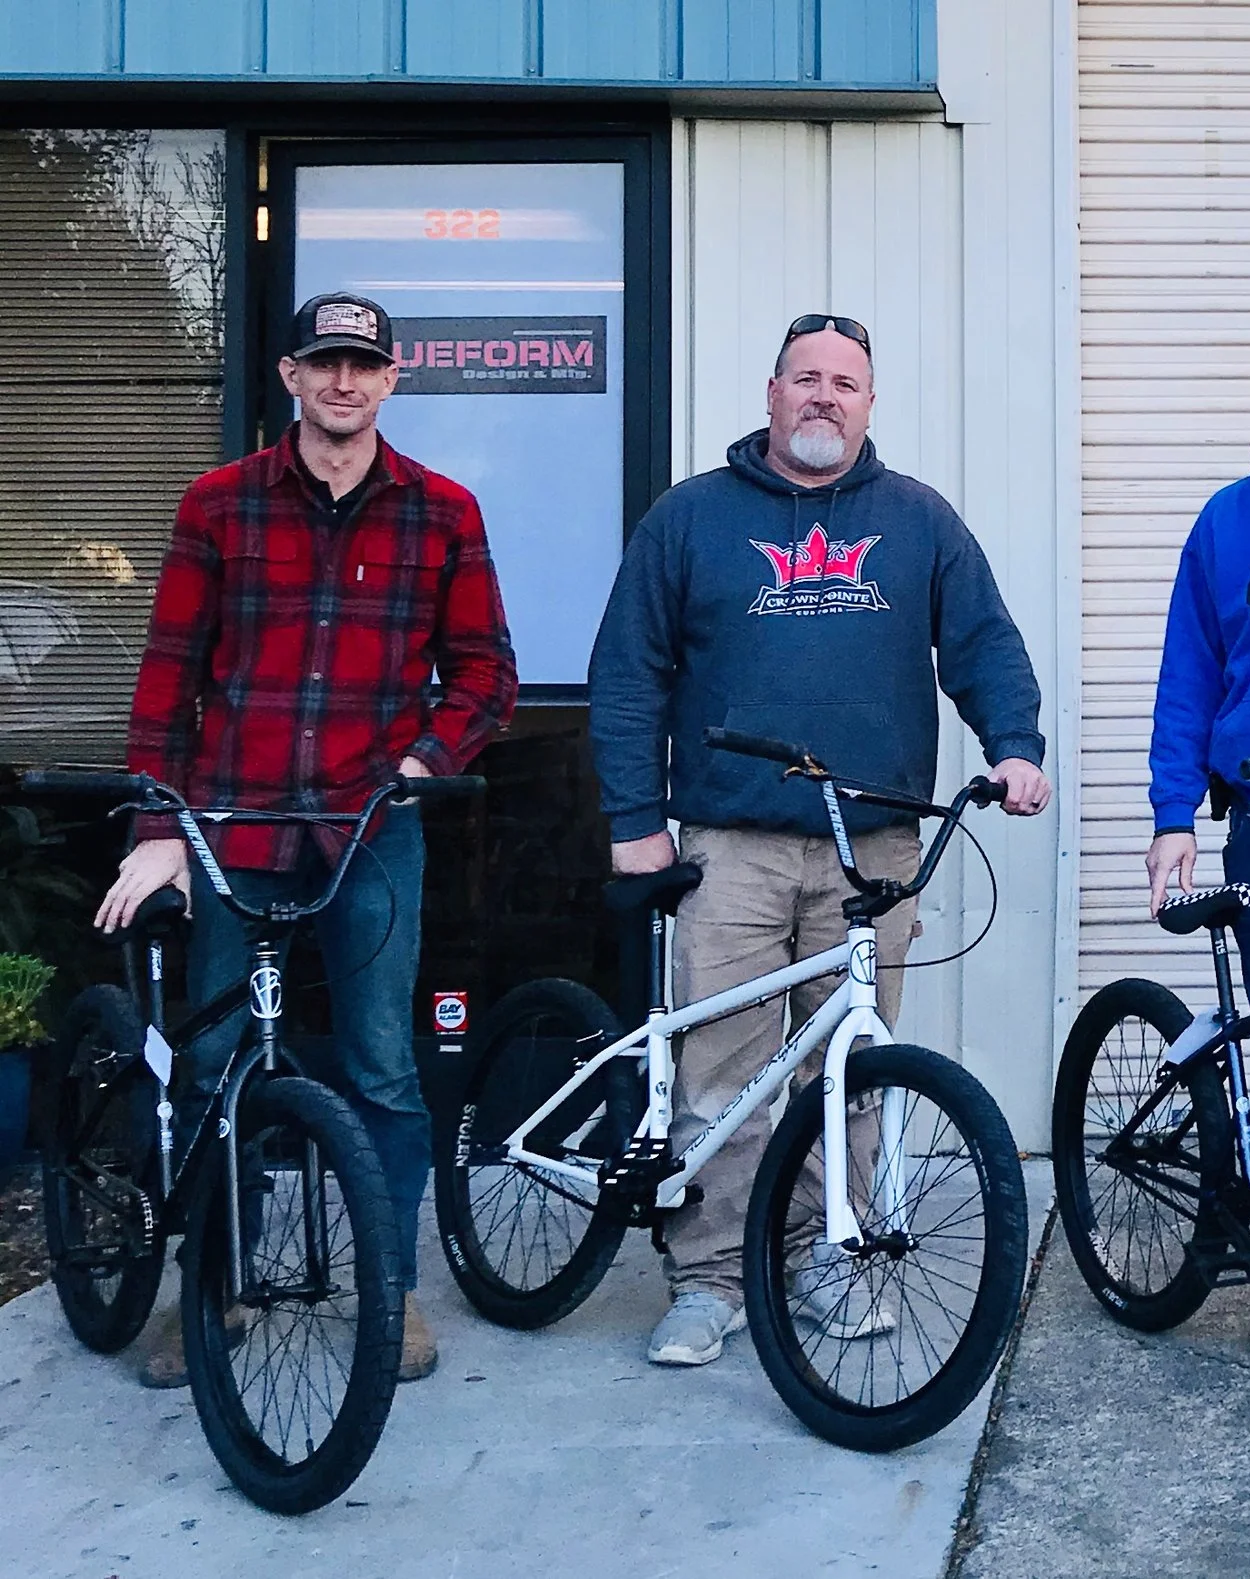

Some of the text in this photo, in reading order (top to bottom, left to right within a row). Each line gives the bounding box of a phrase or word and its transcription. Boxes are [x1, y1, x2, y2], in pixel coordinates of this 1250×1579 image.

[424, 210, 500, 240] 322
[462, 369, 530, 380] Design
[533, 370, 548, 379] &
[439, 1004, 462, 1013] BAY
